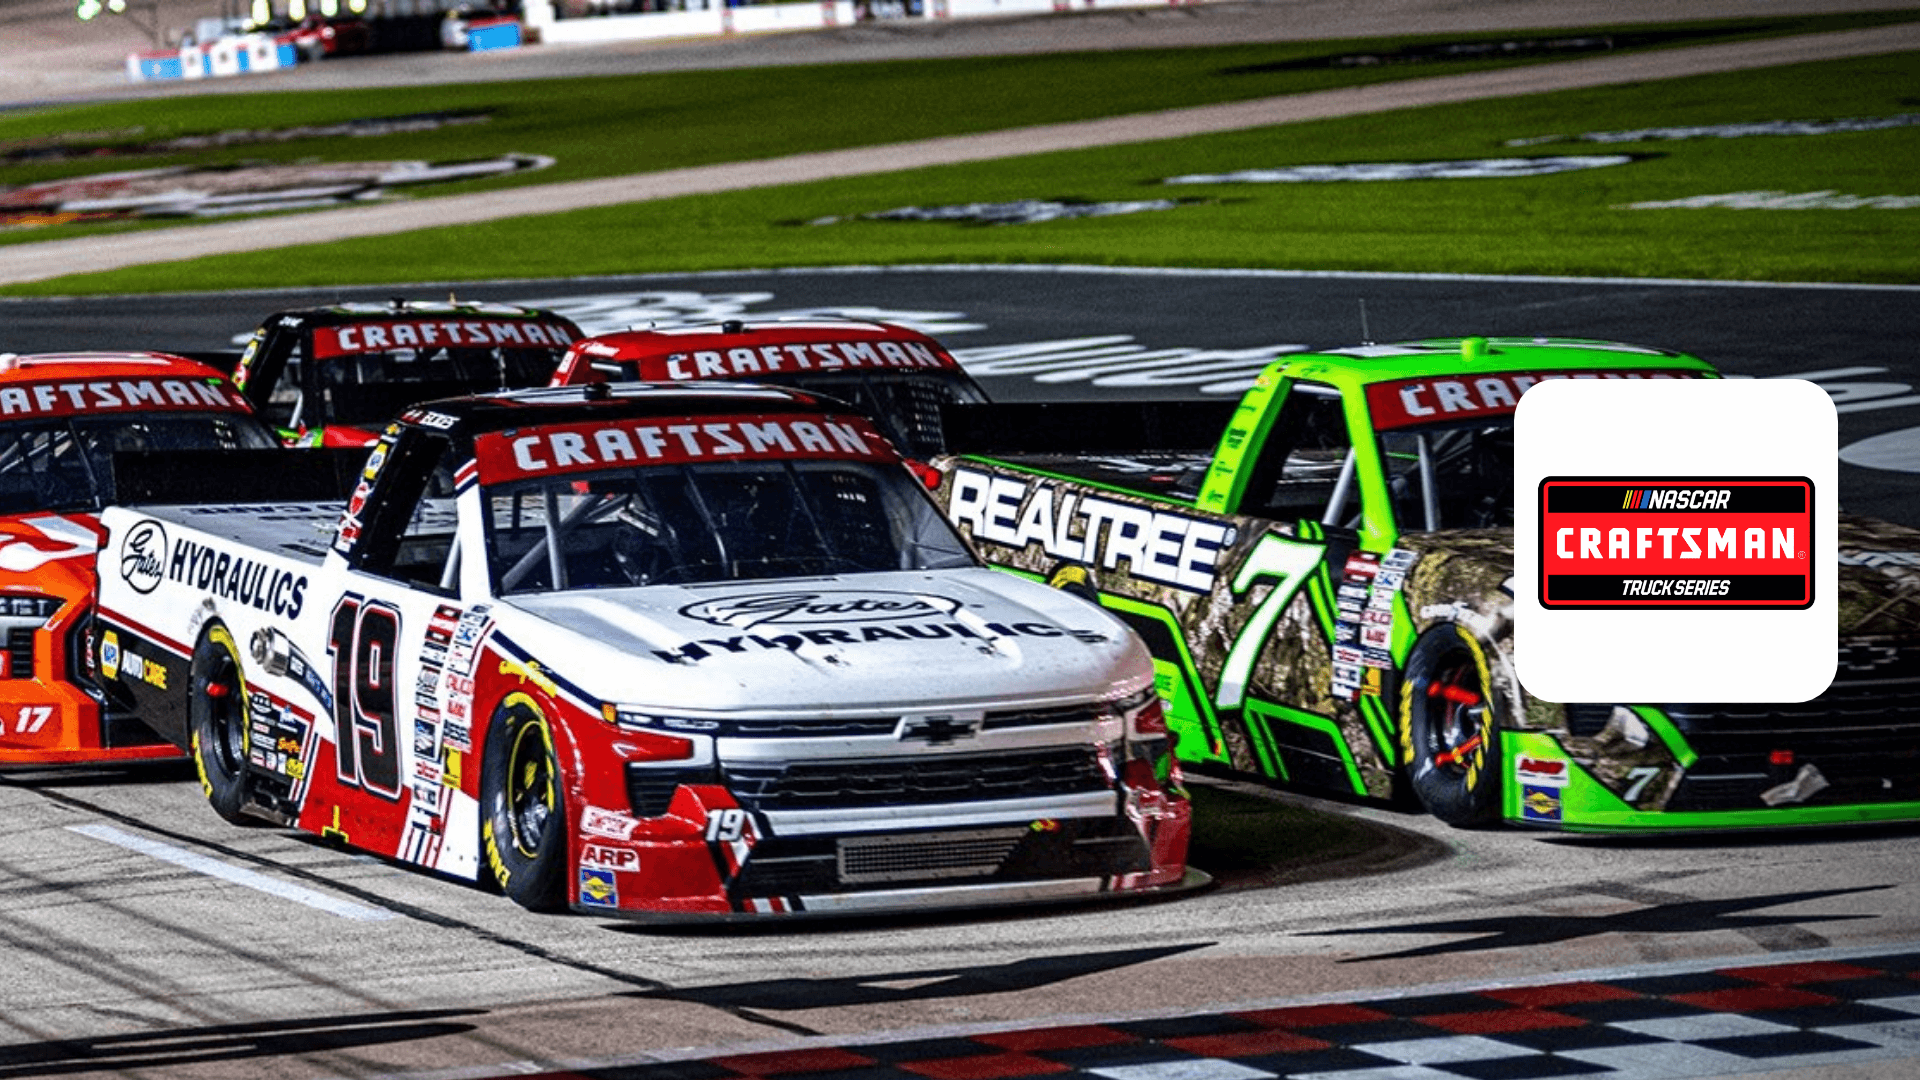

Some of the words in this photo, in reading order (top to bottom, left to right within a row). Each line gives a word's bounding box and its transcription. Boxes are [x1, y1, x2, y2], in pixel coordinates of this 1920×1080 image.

[337, 322, 575, 352] CRAFTSMAN
[667, 341, 942, 381] CRAFTSMAN
[514, 420, 871, 471] CRAFTSMAN
[949, 468, 1225, 590] REALTREE
[169, 538, 308, 620] HYDRAULICS
[1214, 532, 1327, 711] 7
[651, 622, 1110, 664] HYDRAULICS
[330, 590, 402, 800] 19
[15, 706, 53, 733] 17
[1623, 767, 1661, 801] 7
[706, 808, 745, 842] 19
[581, 846, 636, 867] ARP
